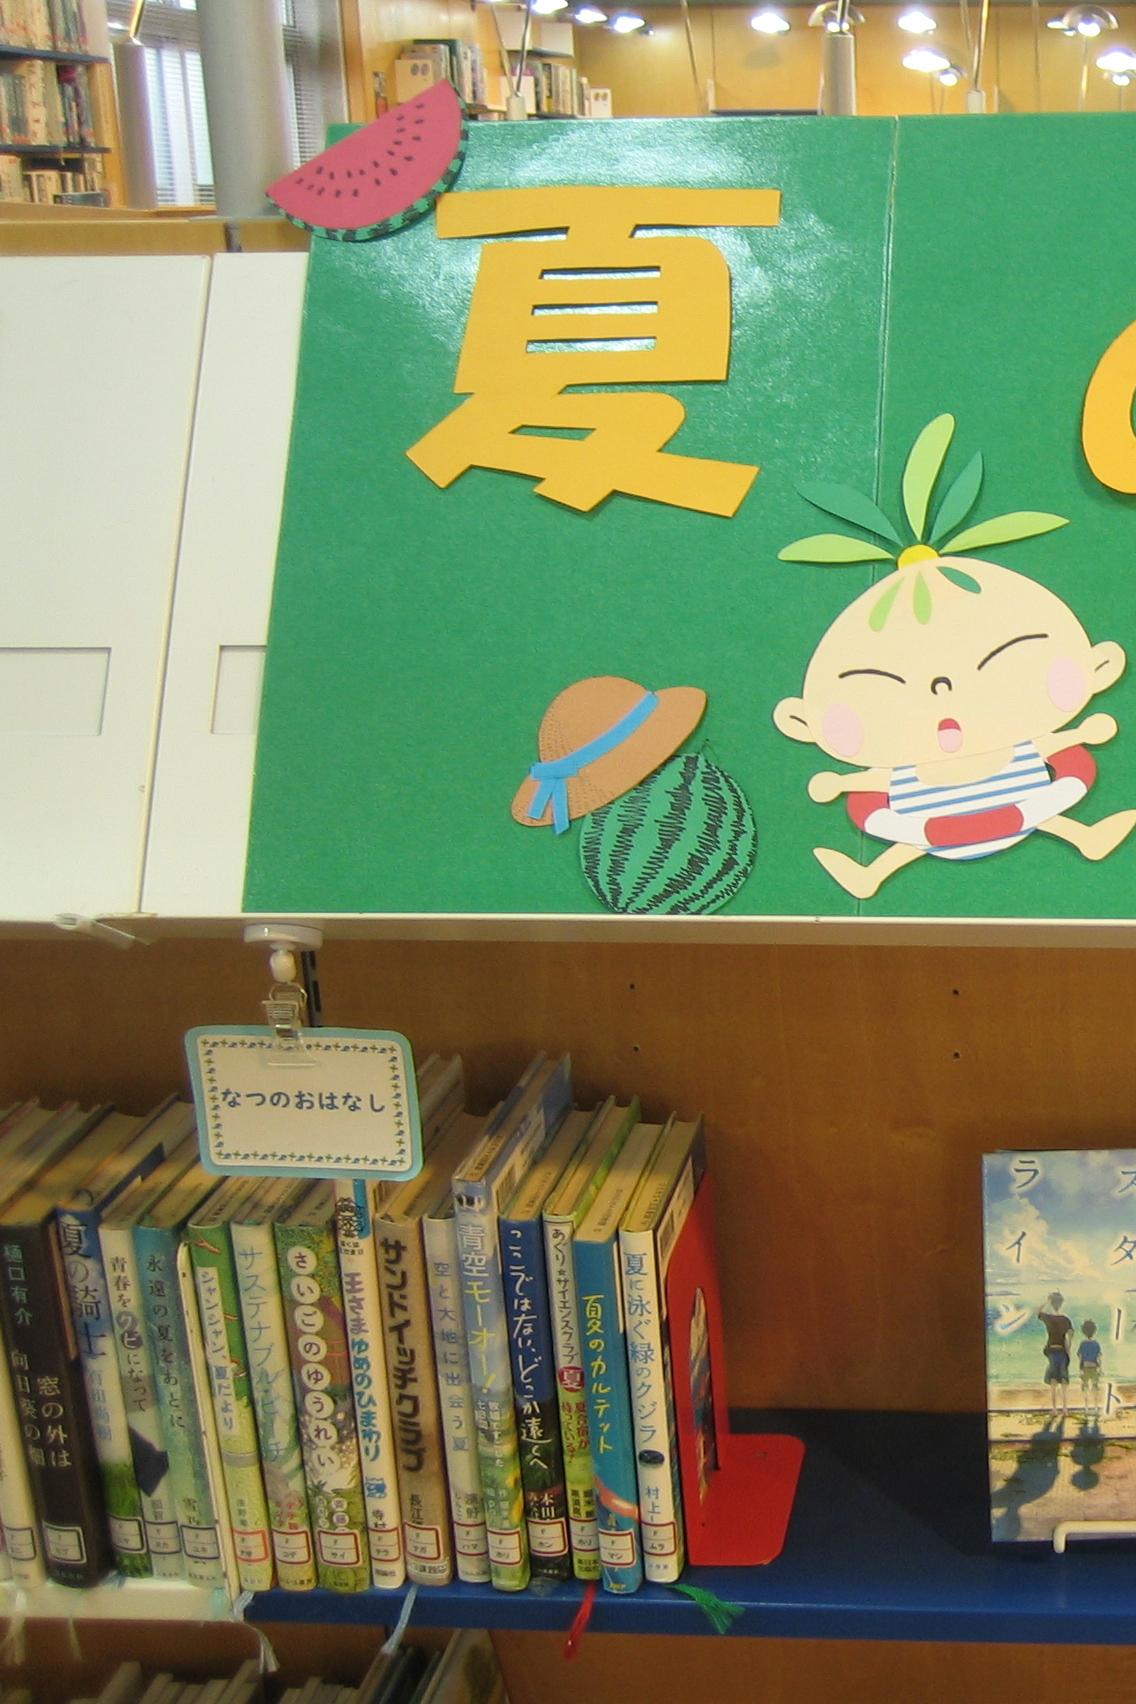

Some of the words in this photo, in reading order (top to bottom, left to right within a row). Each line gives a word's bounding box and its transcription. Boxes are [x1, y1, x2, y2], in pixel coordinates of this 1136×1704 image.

[221, 1088, 386, 1113] なつのおはなし
[997, 1160, 1041, 1334] ライン
[37, 1375, 73, 1468] 窓の外は
[291, 1250, 338, 1468] さいごのゆうれい
[434, 1261, 469, 1452] 空と大地に出会う夏
[562, 1368, 582, 1391] 夏
[582, 1294, 614, 1455] 夏のカルテット
[623, 1252, 659, 1444] 夏に泳ぐ緑のクジラ
